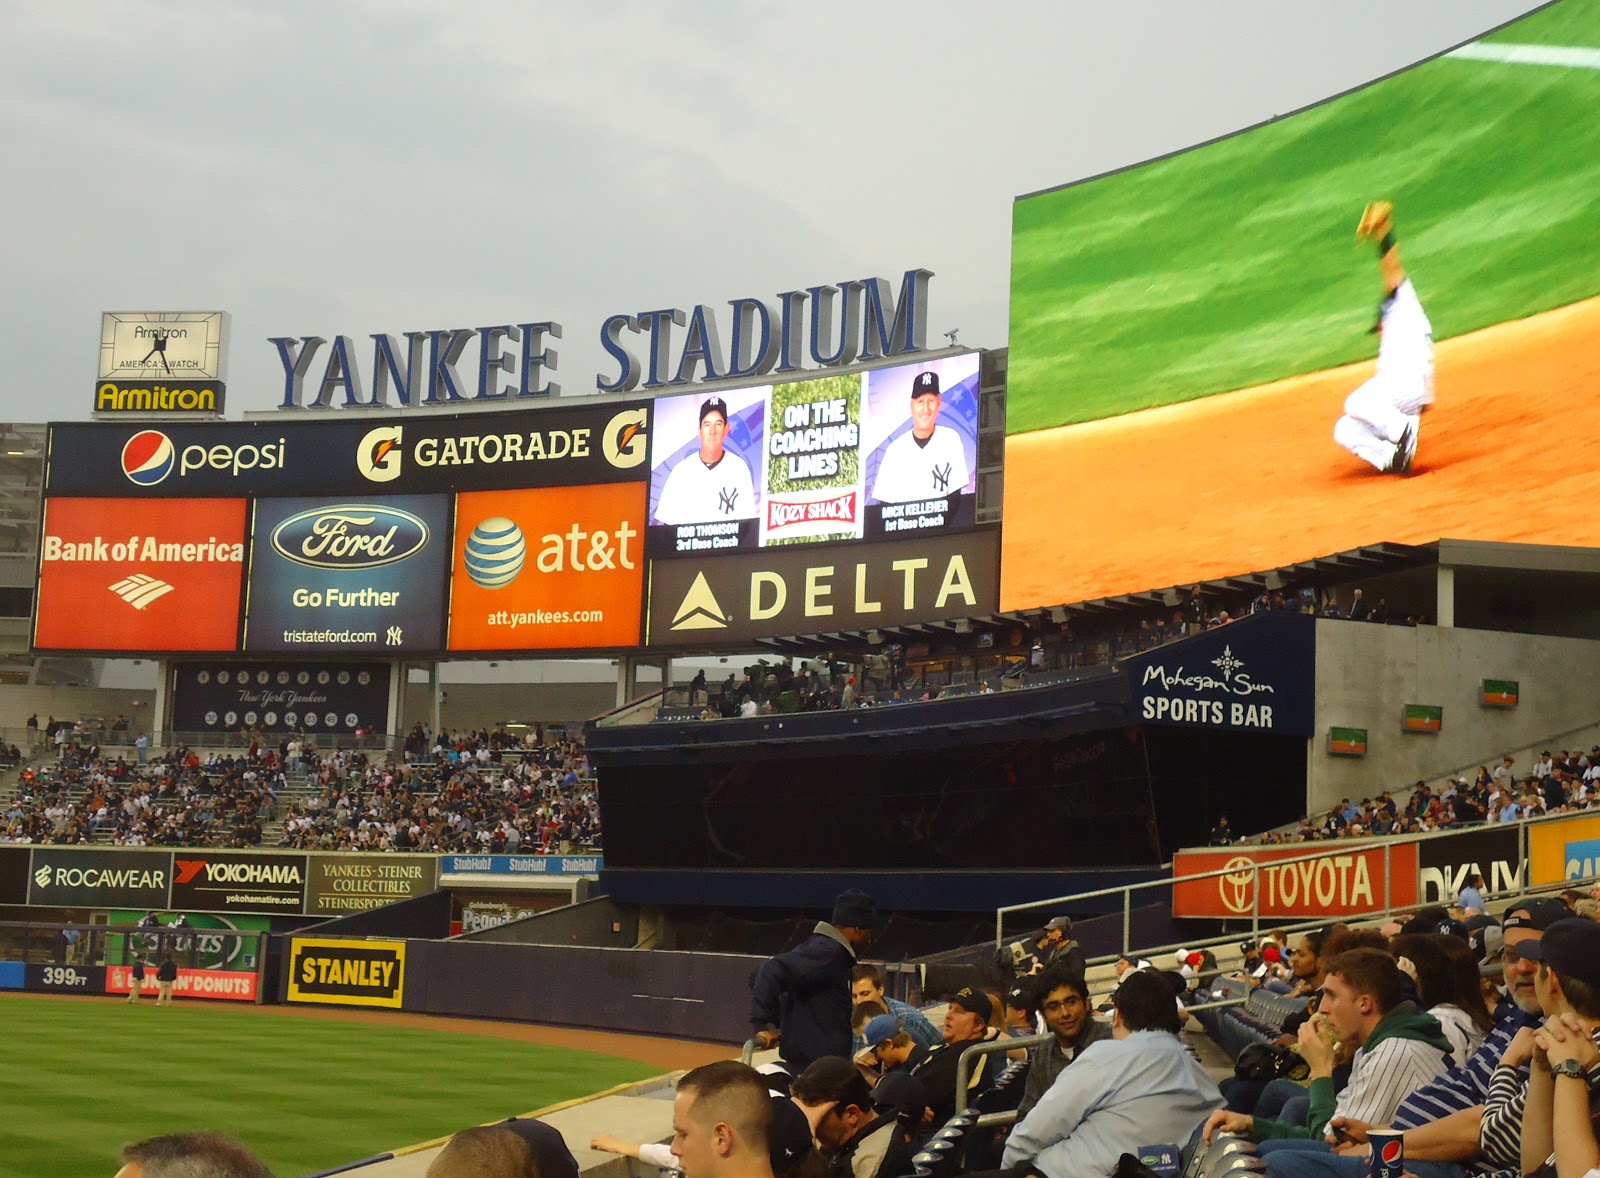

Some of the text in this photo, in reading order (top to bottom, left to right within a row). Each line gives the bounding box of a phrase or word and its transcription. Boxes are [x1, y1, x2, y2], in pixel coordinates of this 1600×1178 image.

[134, 325, 187, 339] Armitron
[267, 268, 935, 410] YANKEE STADIUM
[119, 360, 166, 368] AMERICA'S
[97, 383, 215, 410] Armitron
[784, 398, 846, 428] ON THE
[414, 428, 591, 467] GATORADE
[770, 423, 858, 456] COACHING
[180, 437, 286, 476] pepsi
[788, 451, 838, 480] LINES
[770, 495, 853, 526] KOZY SHACK
[882, 500, 949, 519] MICK KELLEHER
[677, 522, 740, 538] ROB THOMSON
[885, 514, 945, 531] 1st Base Coach
[301, 515, 398, 557] Ford
[536, 520, 637, 573] at&t
[676, 535, 739, 551] 3rd Base Coach
[44, 535, 243, 562] Bank of America
[292, 587, 400, 607] Go Further
[750, 554, 977, 621] DELTA
[487, 609, 603, 629] att.yankees.com
[283, 629, 377, 643] tristateford.com
[1142, 665, 1275, 696] Mohegan Sun
[238, 689, 328, 708] New York Yankees
[1142, 695, 1273, 728] SPORTS BAR
[205, 863, 302, 884] YOKOHAMA
[453, 857, 491, 870] StubHub!
[509, 858, 547, 872] StubHub!
[561, 858, 597, 872] StubHub!
[55, 867, 165, 889] ROCAWEAR
[333, 879, 411, 893] COLLECTIBLES
[1264, 855, 1374, 907] TOYOTA
[1420, 858, 1529, 904] DKNY
[225, 894, 300, 905] yokohamatire.com
[318, 897, 396, 910] STEINERSPORT
[462, 908, 513, 931] Peanut
[302, 957, 395, 988] STANLEY
[193, 976, 251, 994] DONUTS
